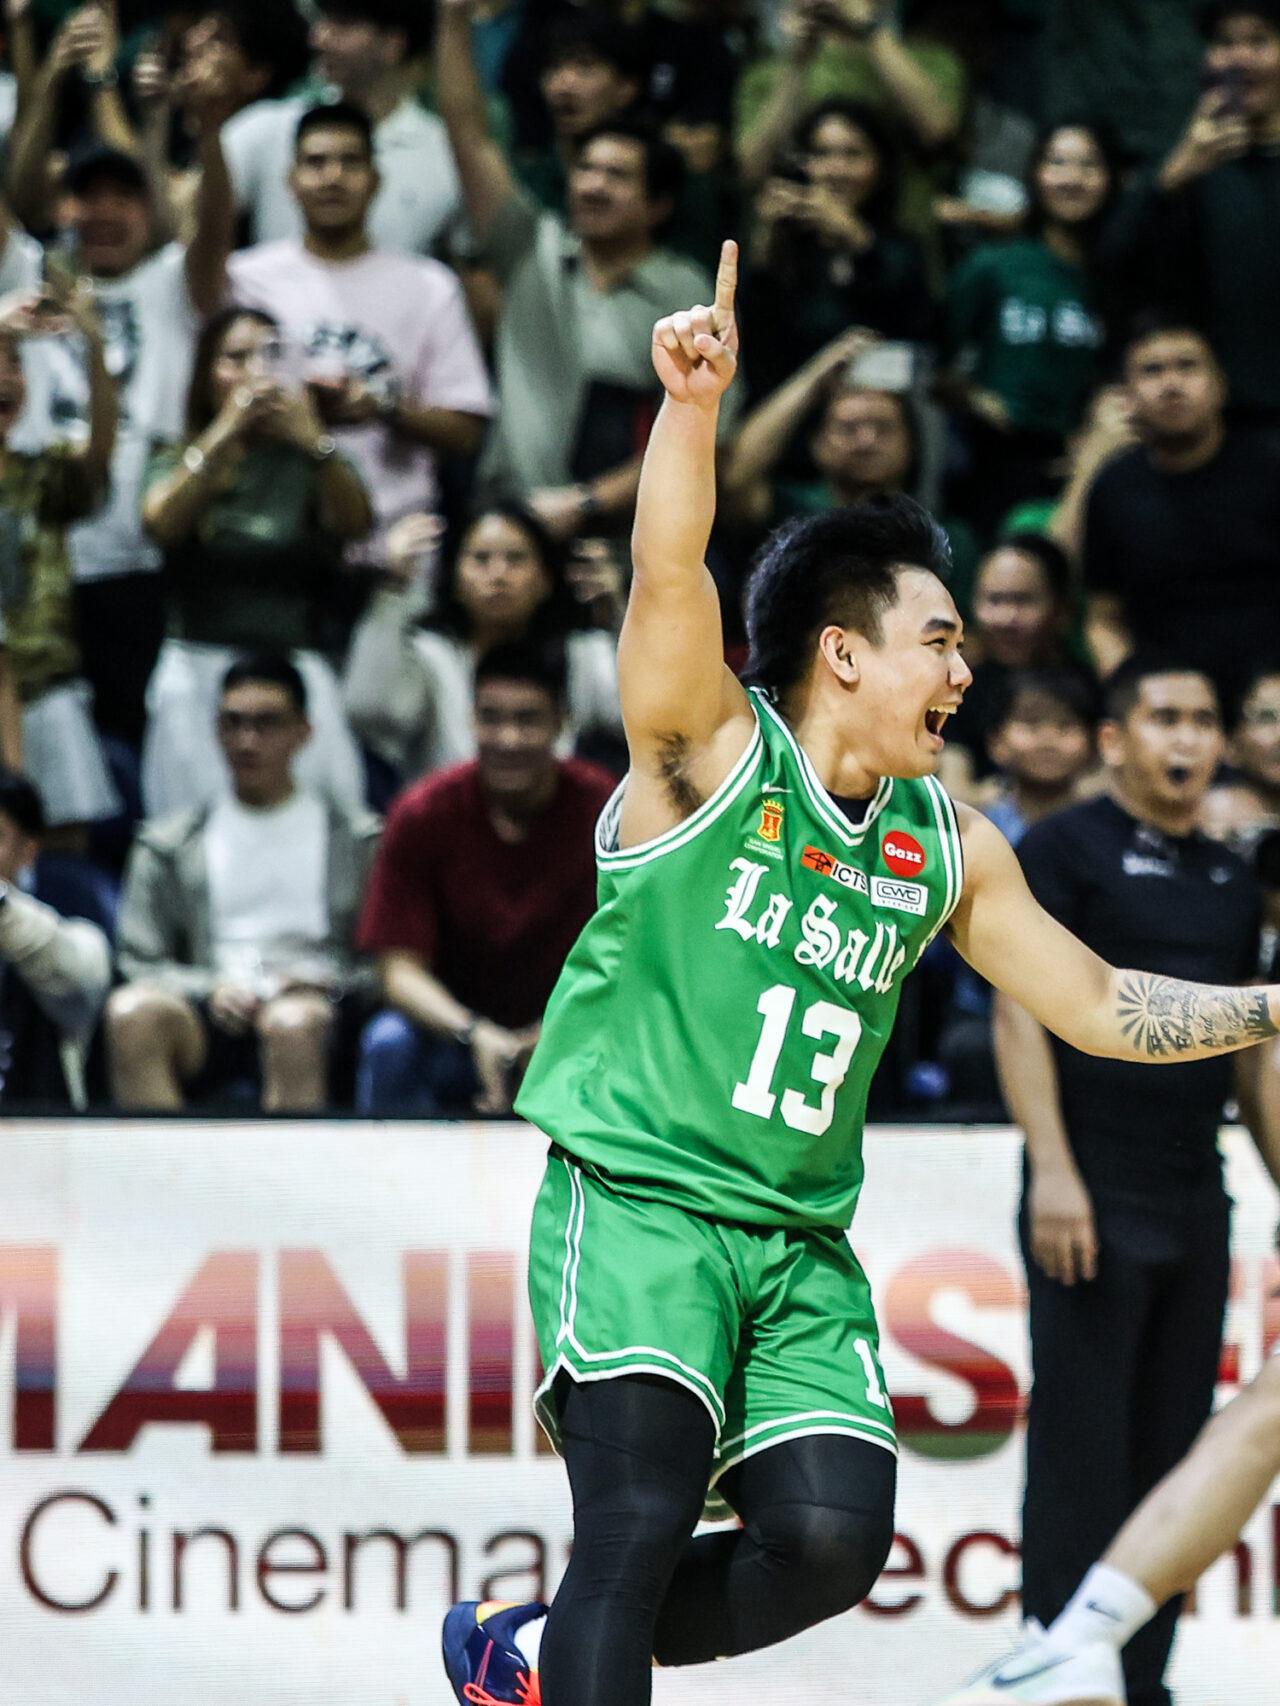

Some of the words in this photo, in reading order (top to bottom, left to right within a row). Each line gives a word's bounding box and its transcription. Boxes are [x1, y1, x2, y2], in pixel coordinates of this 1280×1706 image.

[880, 885, 918, 901] CWC
[883, 842, 922, 864] Gazz
[714, 856, 794, 949] La
[793, 893, 906, 994] Salle
[731, 984, 862, 1137] 13
[853, 1338, 894, 1417] 1
[20, 1489, 572, 1614] Cinema
